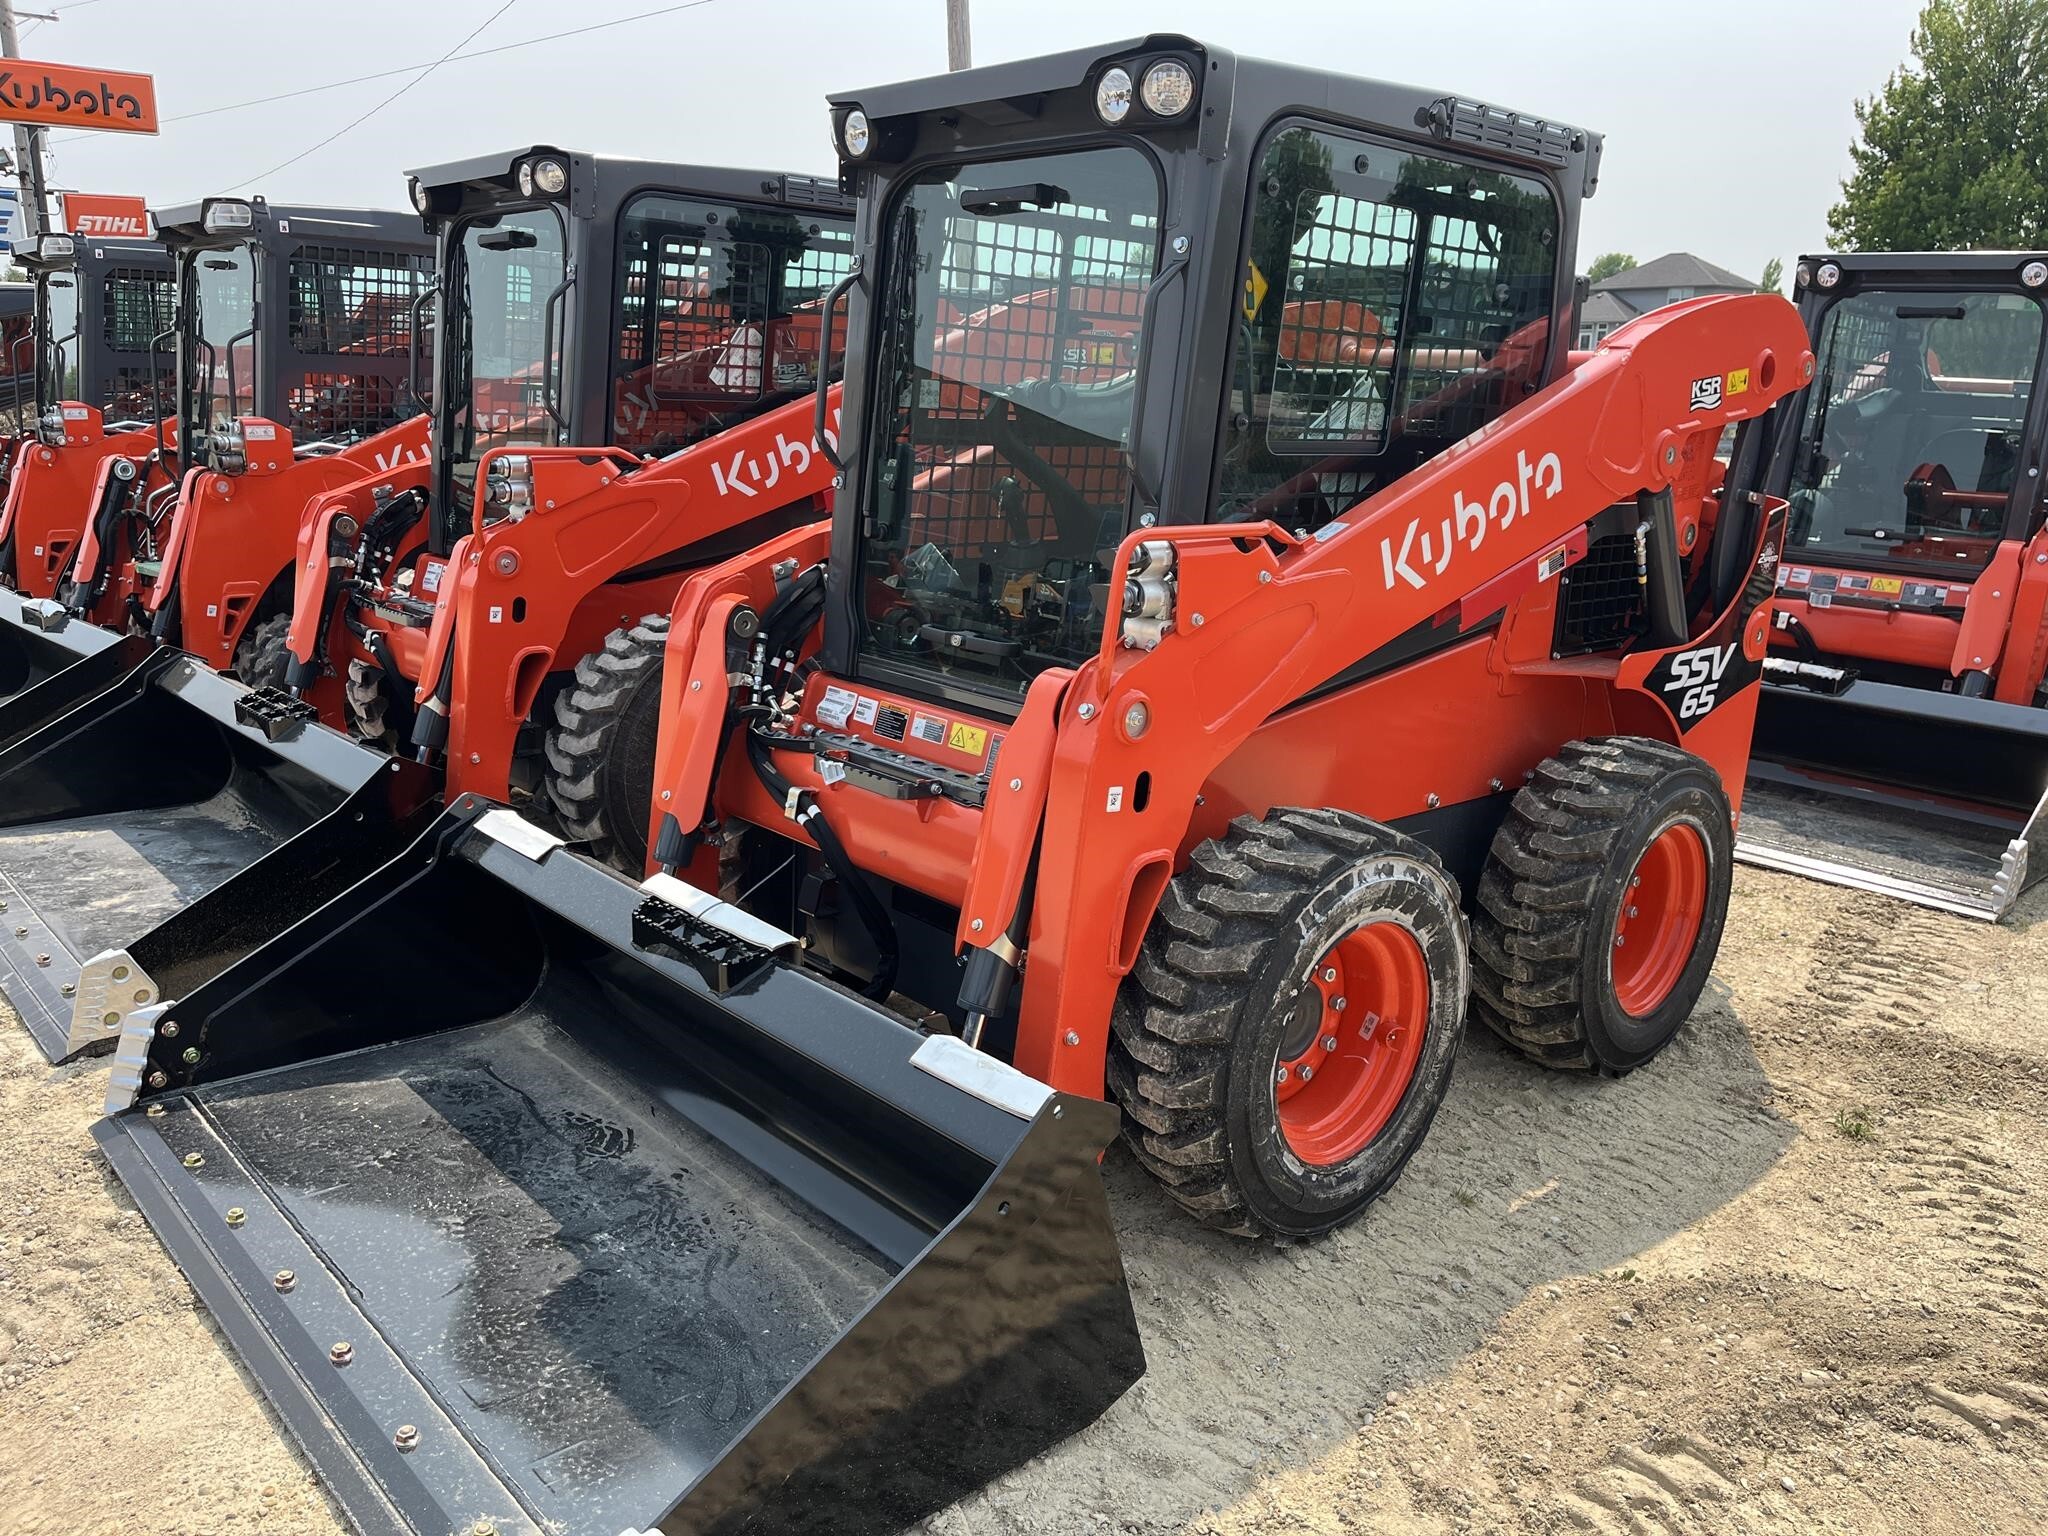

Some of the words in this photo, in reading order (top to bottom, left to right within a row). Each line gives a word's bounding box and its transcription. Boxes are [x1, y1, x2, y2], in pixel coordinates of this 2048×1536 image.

[0, 72, 141, 119] Kubota
[76, 215, 143, 233] STIHL
[1691, 376, 1721, 398] KSR
[711, 408, 840, 496] Kubo
[1380, 449, 1563, 591] Kubota
[1664, 642, 1737, 691] SSV
[1680, 683, 1719, 718] 65
